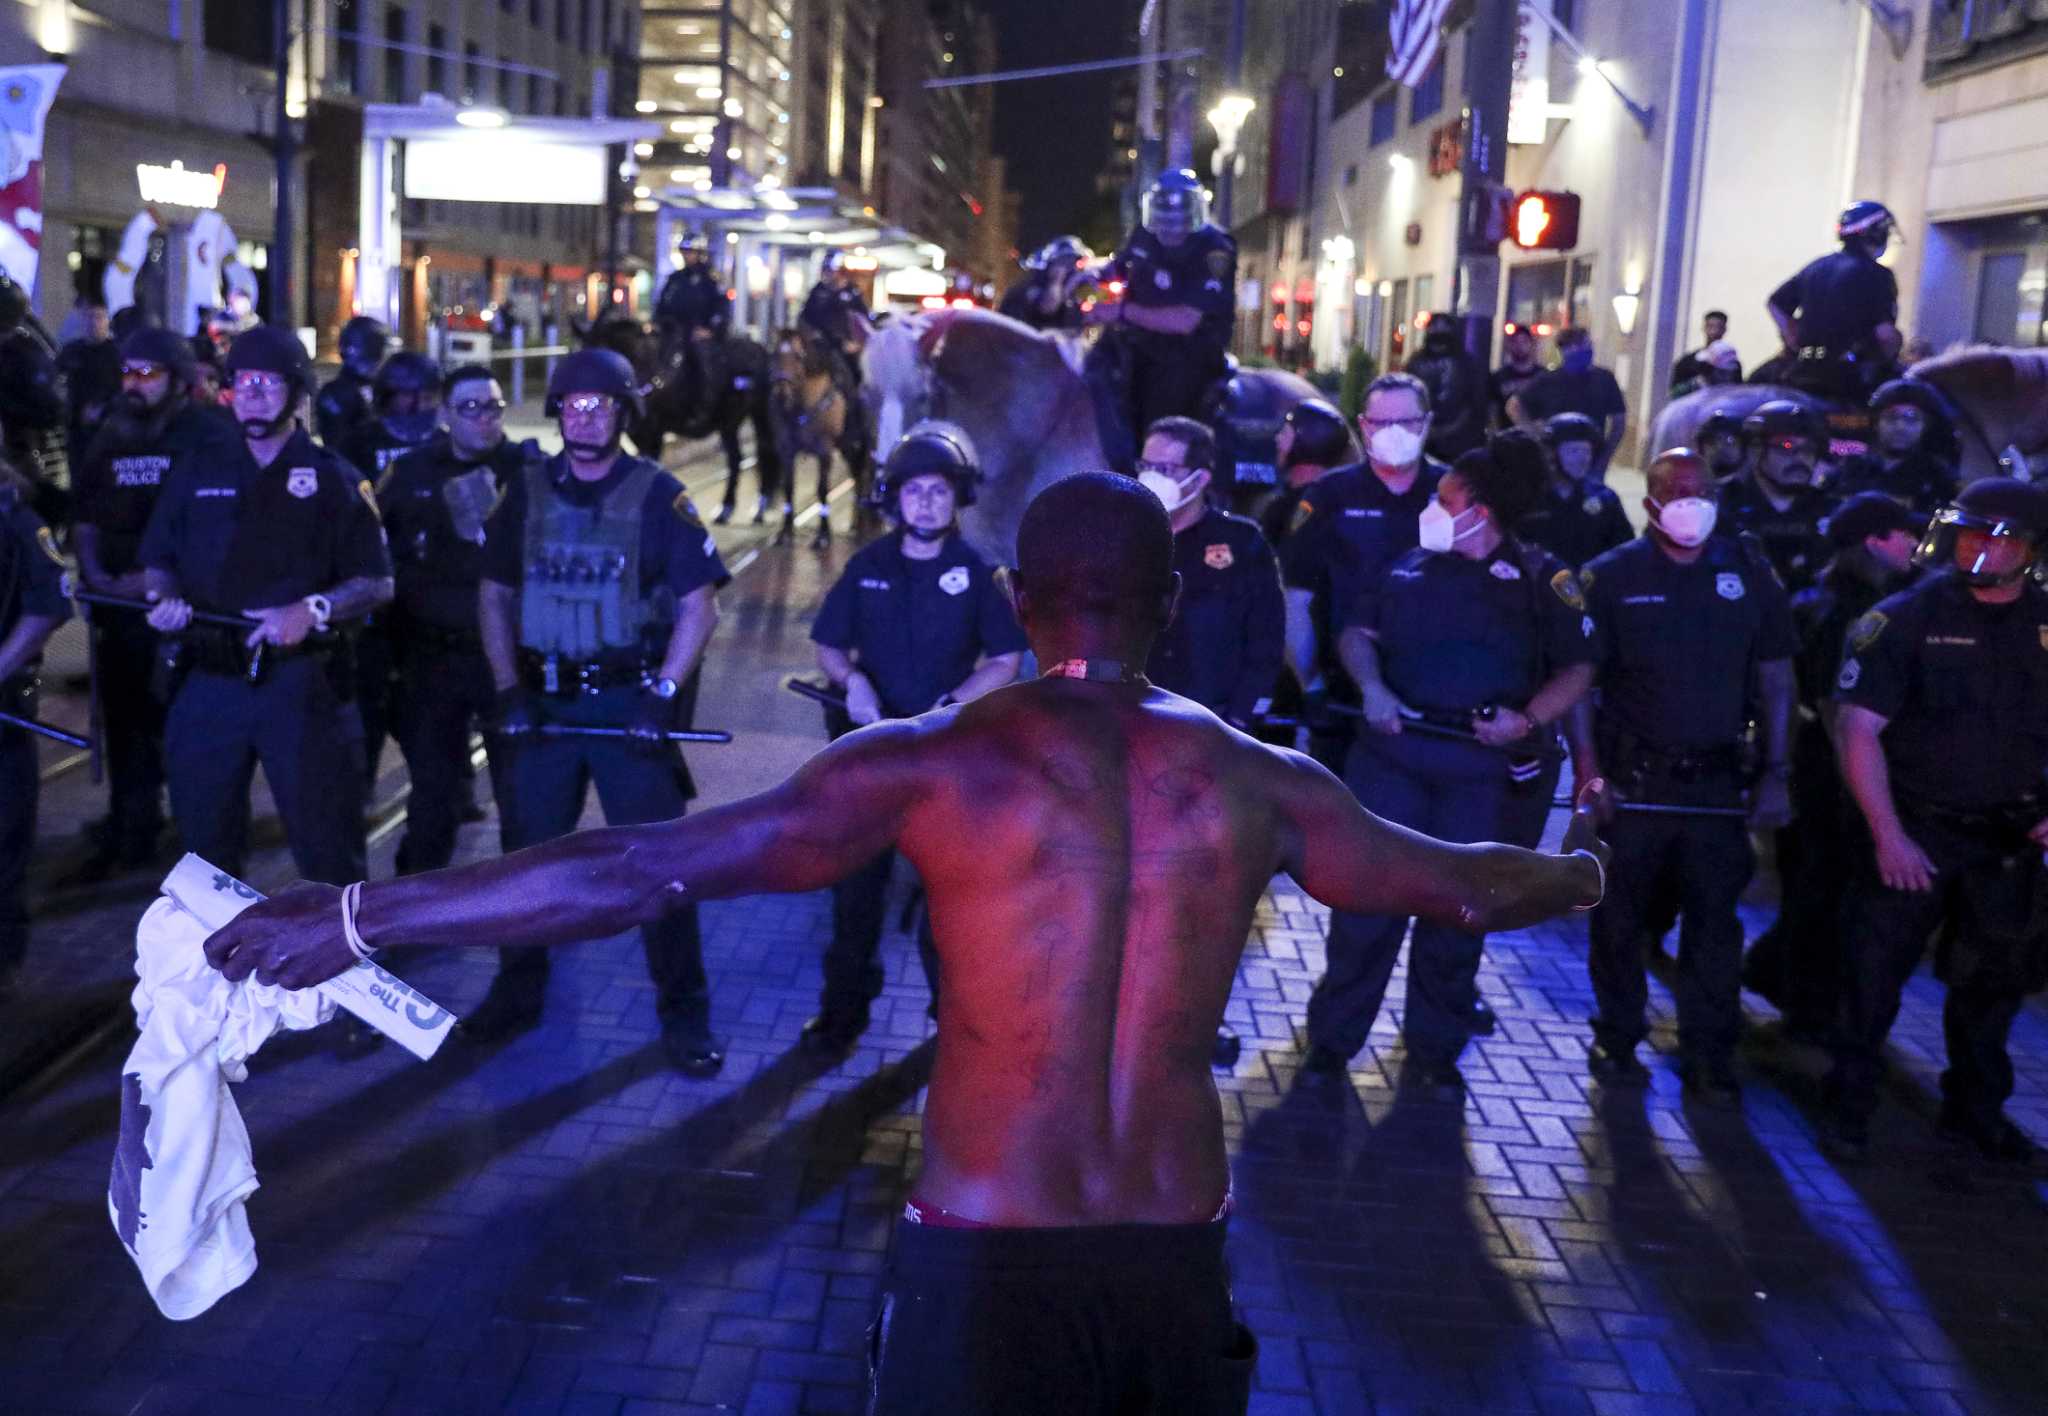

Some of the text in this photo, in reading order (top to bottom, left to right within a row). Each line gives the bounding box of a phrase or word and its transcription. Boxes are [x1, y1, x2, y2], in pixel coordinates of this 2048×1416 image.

[112, 455, 171, 473] HOUSTON
[116, 470, 161, 486] POLICE
[369, 982, 401, 1014] The
